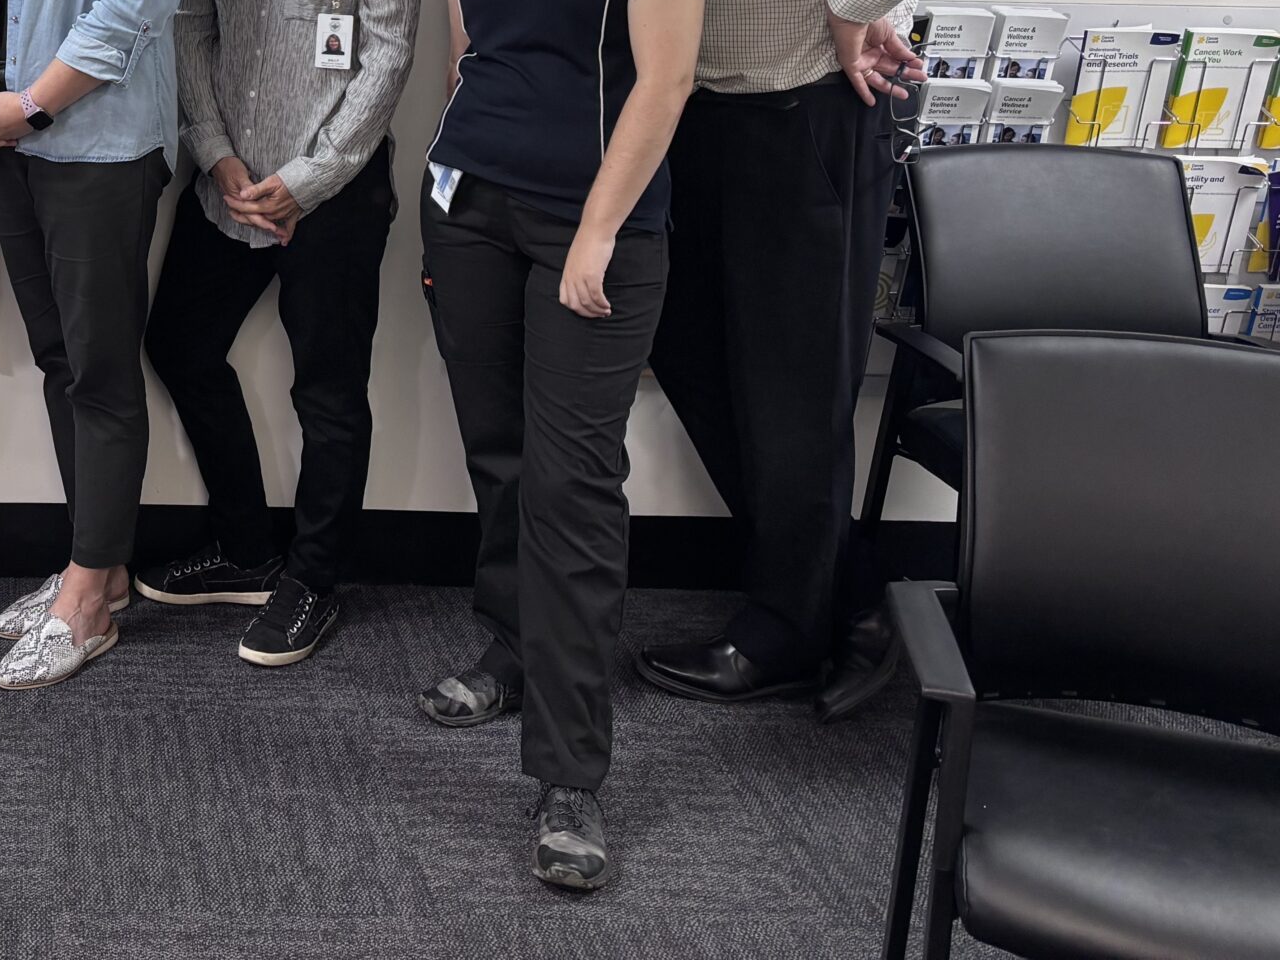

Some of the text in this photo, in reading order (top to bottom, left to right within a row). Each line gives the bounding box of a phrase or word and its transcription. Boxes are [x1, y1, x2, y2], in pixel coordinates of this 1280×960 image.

[1008, 25, 1030, 33] Cancer
[1006, 33, 1034, 41] Wellness
[1118, 52, 1139, 60] Trials
[1194, 48, 1243, 56] Cancer, Work
[1086, 60, 1102, 68] and
[1207, 56, 1222, 64] You
